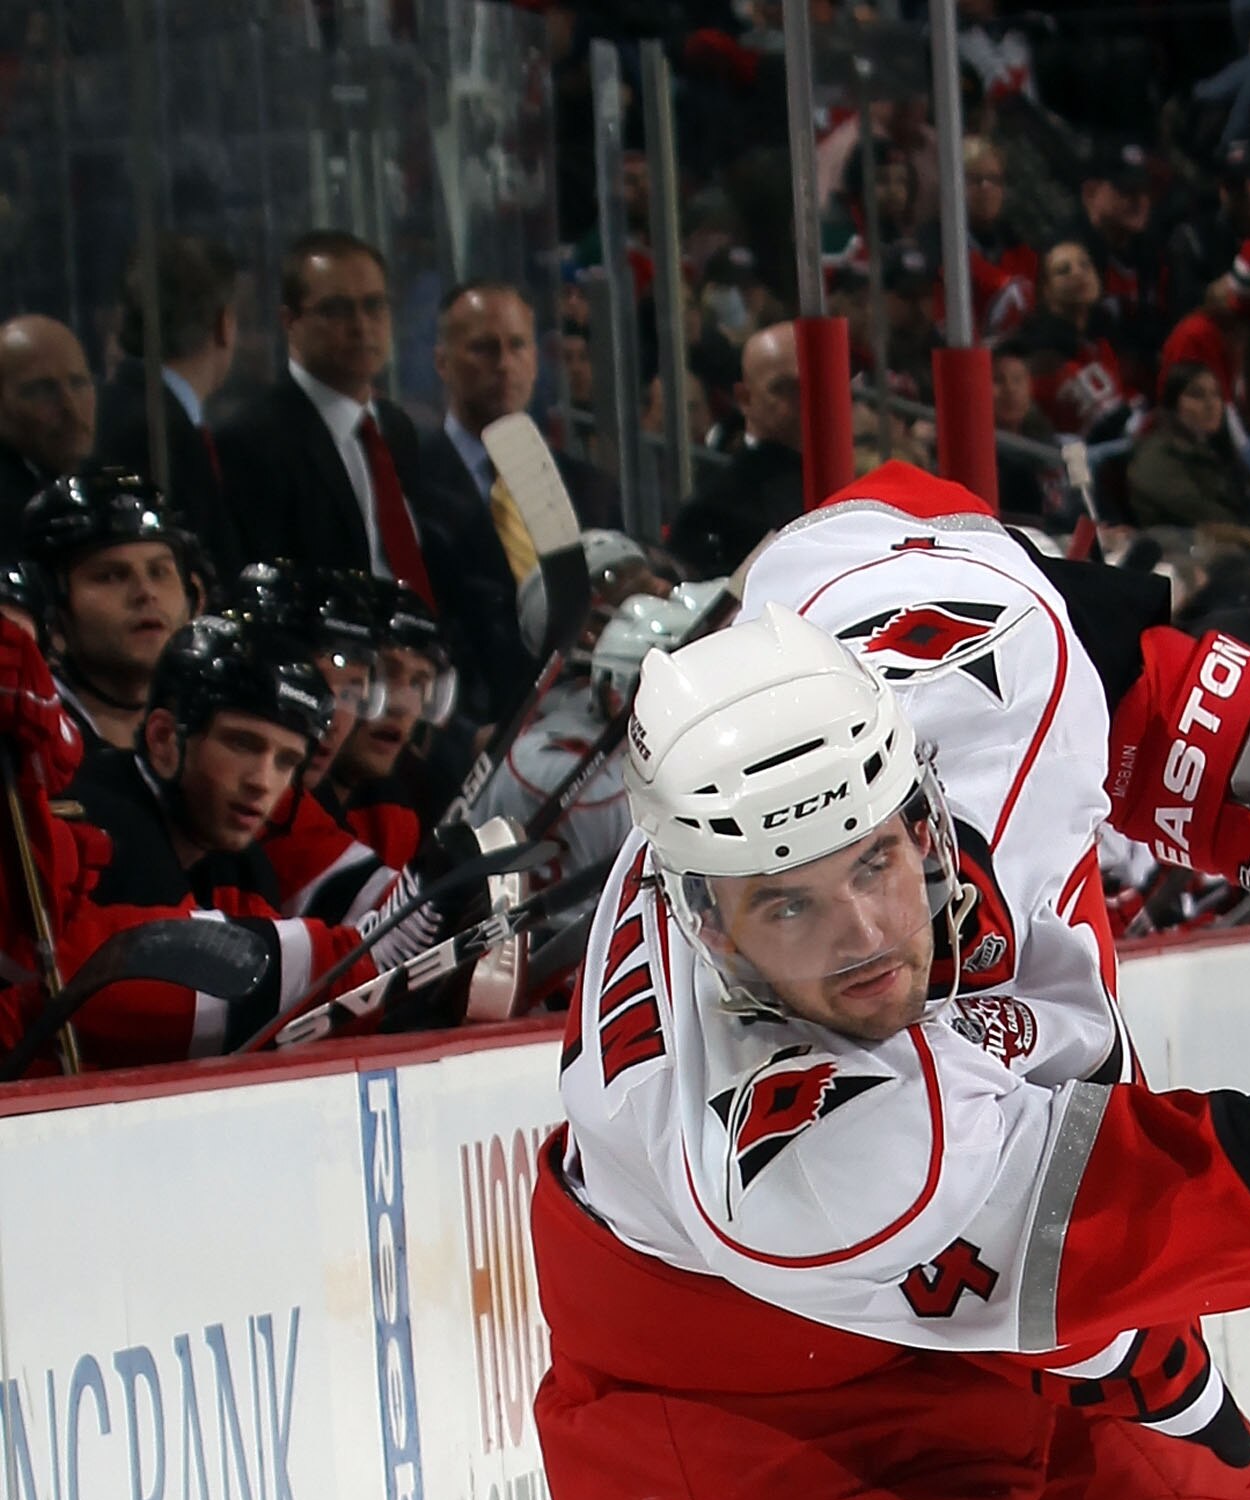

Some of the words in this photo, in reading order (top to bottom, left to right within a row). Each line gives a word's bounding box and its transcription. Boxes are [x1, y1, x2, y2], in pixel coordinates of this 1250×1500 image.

[761, 780, 848, 830] CCM
[1112, 744, 1137, 799] MCBAIN
[459, 1121, 561, 1455] HOC
[898, 1236, 1000, 1319] 4
